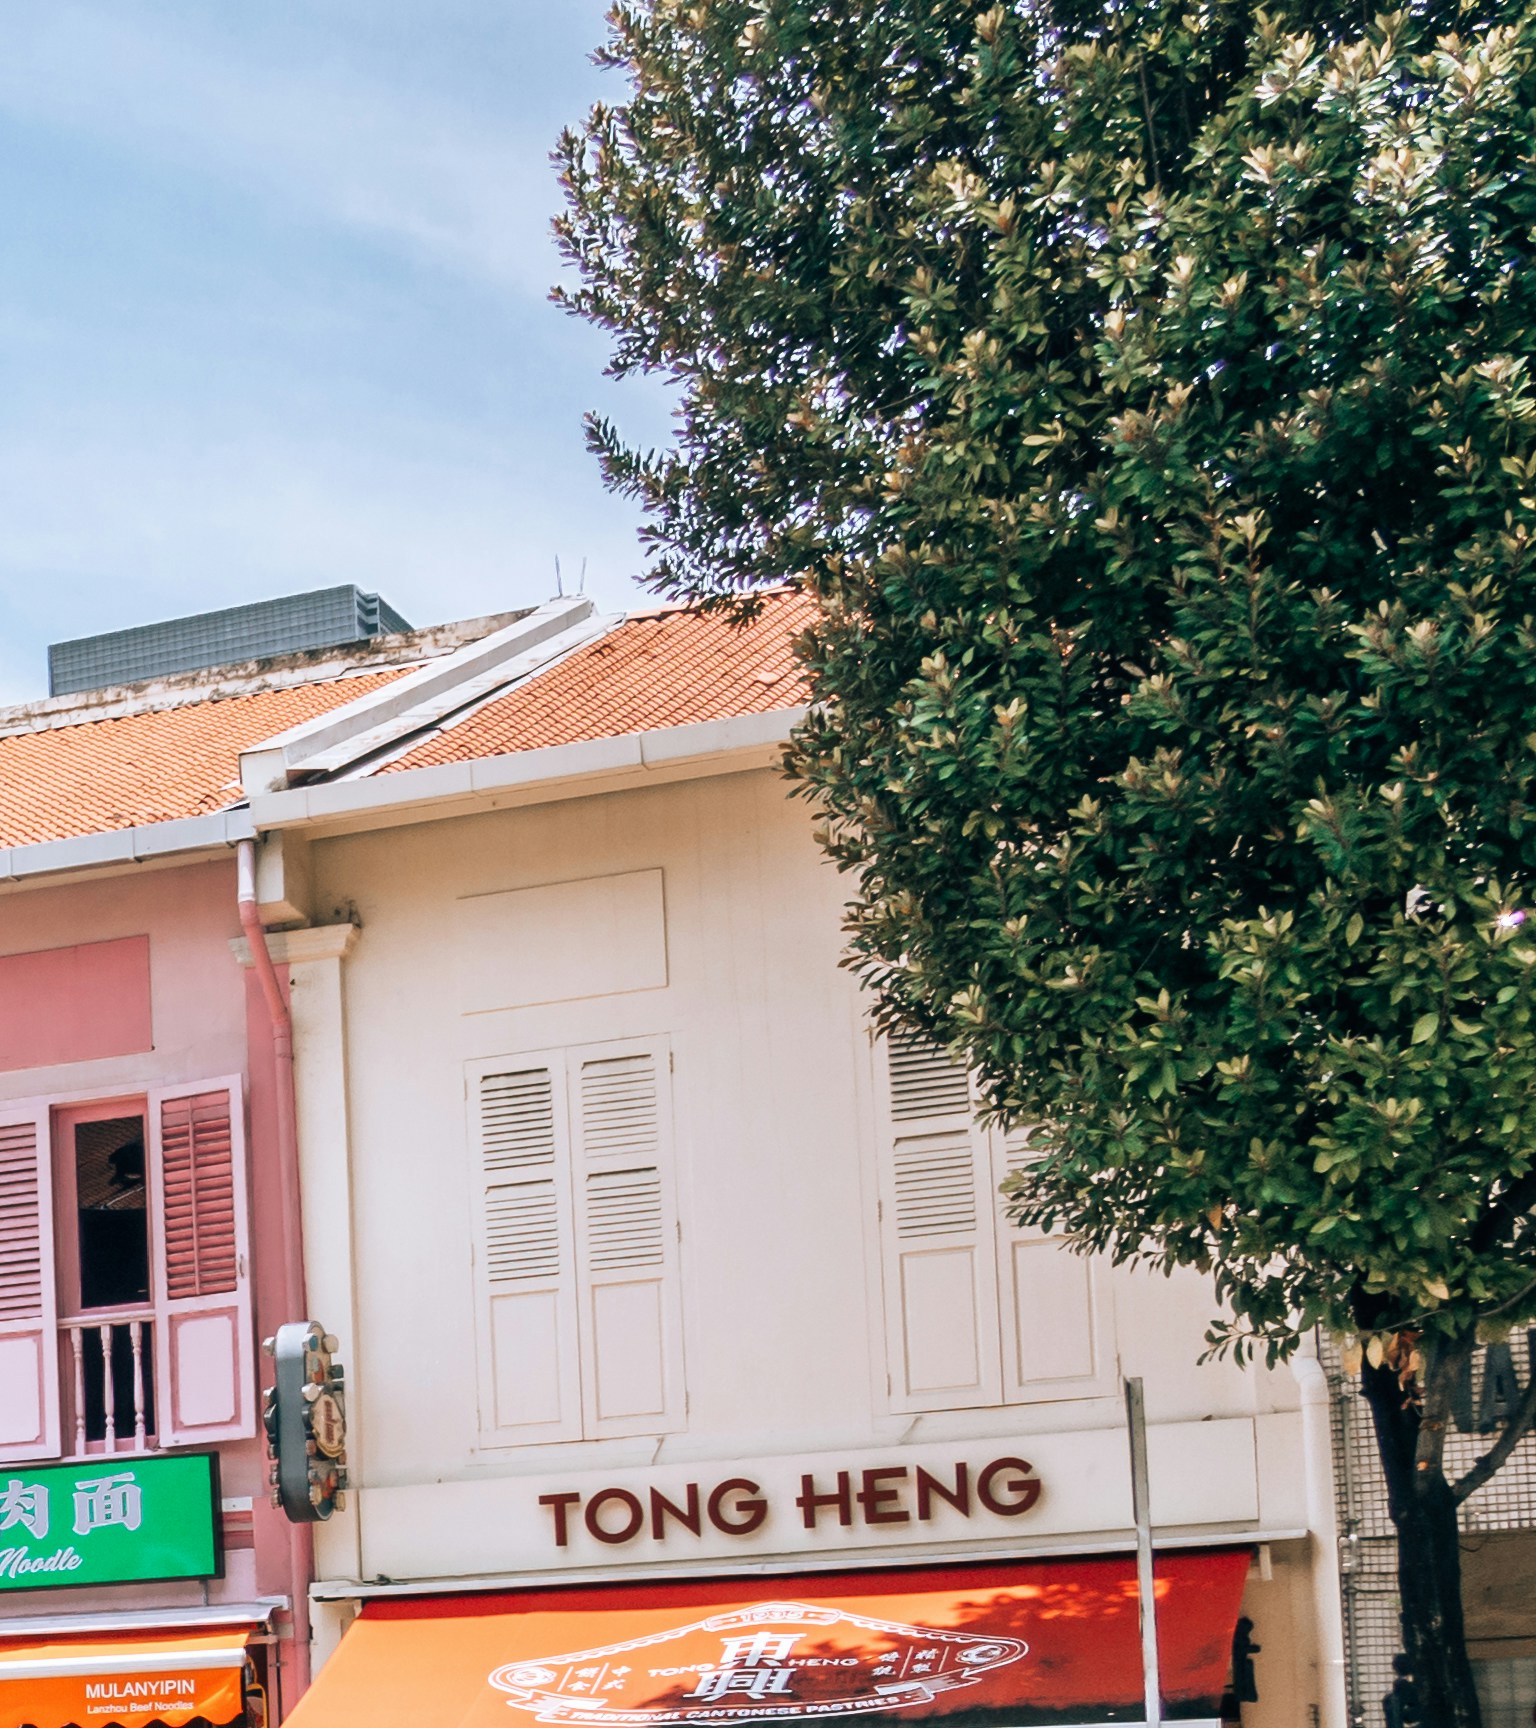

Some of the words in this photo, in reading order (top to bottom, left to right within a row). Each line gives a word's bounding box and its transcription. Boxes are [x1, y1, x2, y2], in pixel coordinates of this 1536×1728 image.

[539, 1478, 767, 1547] TONG
[796, 1455, 1043, 1530] HENG
[647, 1662, 716, 1678] TONG
[788, 1657, 859, 1667] HENG
[683, 1631, 808, 1702] 東興
[85, 1678, 195, 1701] MULANYIPIN
[87, 1702, 128, 1716] Lanzhou
[130, 1702, 153, 1714] Beef
[155, 1699, 194, 1713] Noodles
[685, 1705, 802, 1720] CANTONESE
[806, 1696, 900, 1713] PASTRIES
